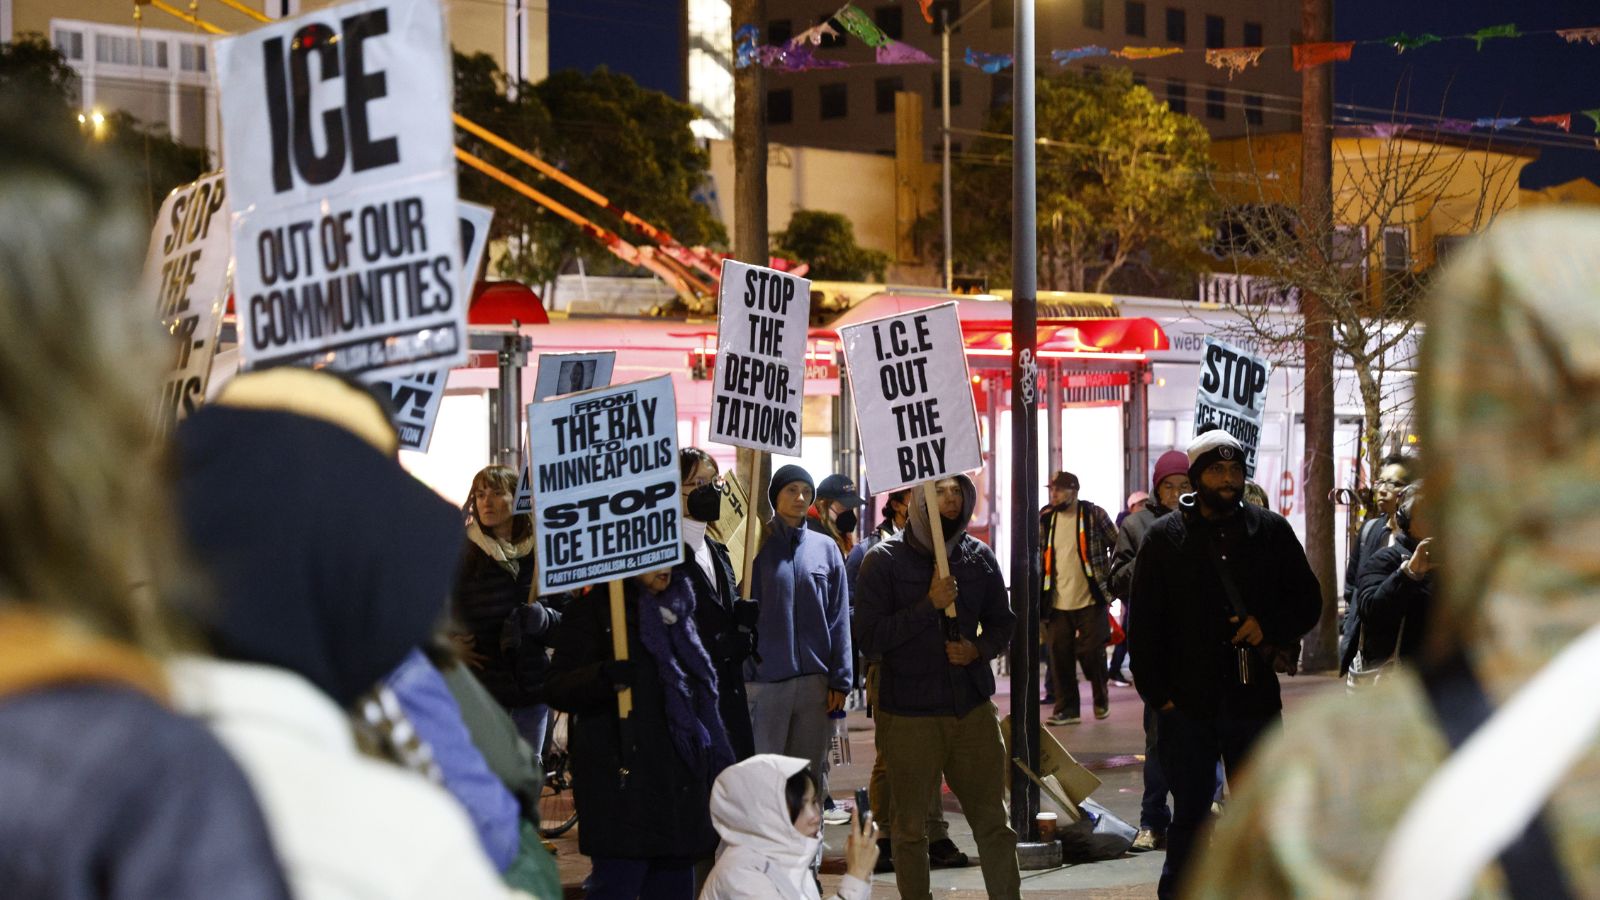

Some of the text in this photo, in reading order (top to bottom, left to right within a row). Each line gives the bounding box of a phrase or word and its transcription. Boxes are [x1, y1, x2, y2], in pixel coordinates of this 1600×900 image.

[263, 8, 402, 194] ICE
[164, 176, 225, 256] STOP
[258, 218, 315, 286] OUT
[321, 210, 353, 273] OF
[360, 197, 428, 264] OUR
[157, 249, 202, 316] THE
[250, 255, 453, 352] COMMUNITIES
[744, 268, 795, 316] STOP
[748, 313, 785, 357] THE
[872, 315, 933, 362] I.C.E
[723, 352, 796, 404] DEPOR-
[879, 357, 928, 401] OUT
[1202, 344, 1265, 410] STOP
[552, 397, 658, 456] THE BAY
[575, 393, 634, 414] FROM
[716, 395, 797, 449] TATIONS
[892, 398, 943, 442] THE
[1197, 403, 1259, 447] ICE TERROR
[539, 437, 672, 493] MINNEAPOLIS
[592, 441, 621, 454] TO
[897, 437, 946, 483] BAY
[543, 481, 677, 530] STOP
[545, 507, 677, 567] ICE TERROR
[548, 547, 676, 585] PARTY FOR SOCIALISM & LIBERATION
